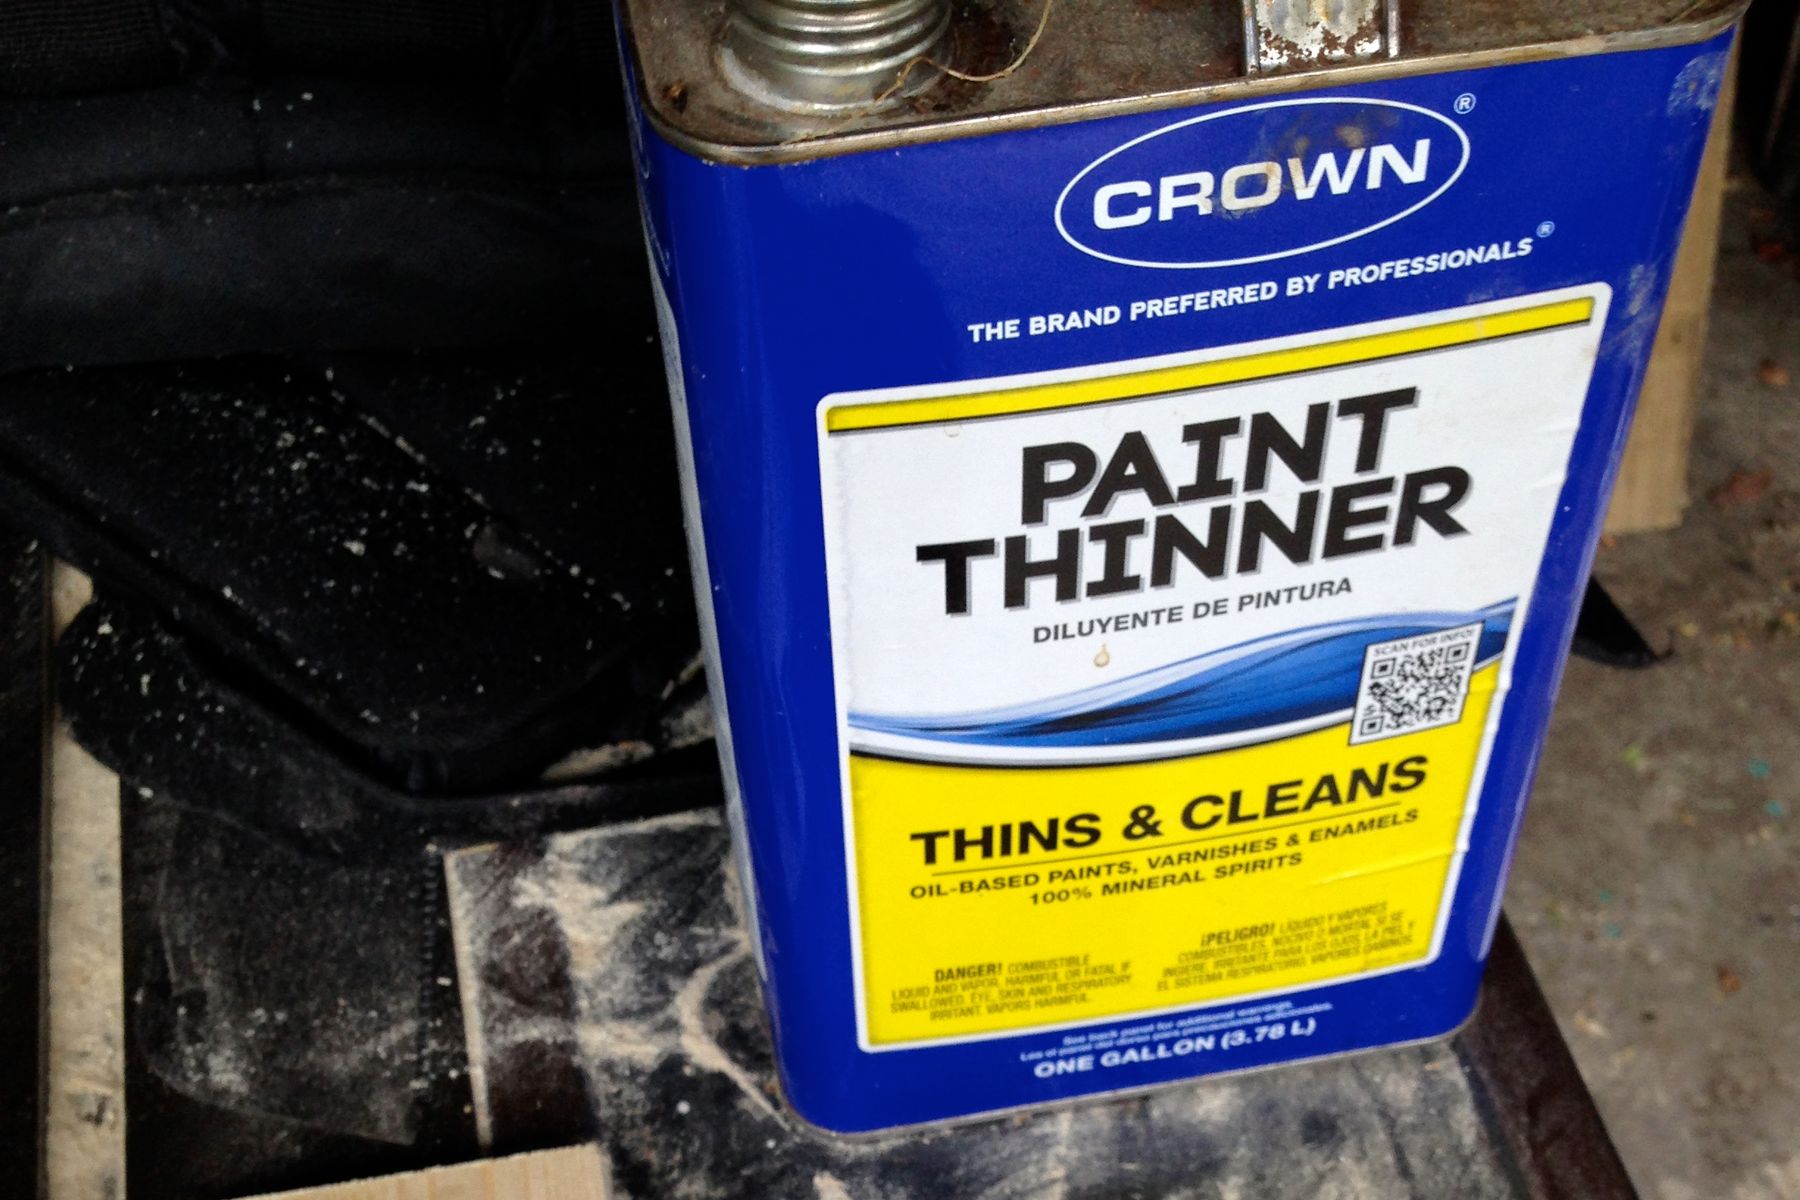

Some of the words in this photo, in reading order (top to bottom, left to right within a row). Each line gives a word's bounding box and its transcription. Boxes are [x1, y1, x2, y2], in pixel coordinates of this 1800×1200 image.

[1093, 138, 1431, 230] CROWN
[967, 319, 1021, 343] THE
[1028, 305, 1122, 336] BRAND
[1129, 281, 1279, 321] PREFERRED
[1286, 273, 1322, 297] BY
[1327, 237, 1534, 290] PROFESSIONALS
[1021, 386, 1418, 525] PAINT
[915, 465, 1474, 616] THINNER
[1033, 603, 1186, 644] DILUYENTE
[1193, 598, 1225, 620] DE
[1238, 577, 1353, 612] PINTURA
[1374, 641, 1409, 656] SCAN
[1412, 636, 1438, 649] FOR
[910, 812, 1101, 866] THINS
[1122, 804, 1163, 841] &
[1181, 755, 1428, 832] CLEANS
[910, 873, 1040, 899] OIL-BASED
[1049, 860, 1138, 883] PAINTS,
[1147, 836, 1278, 870] VARNISHES
[1286, 833, 1300, 847] &
[1309, 808, 1419, 843] ENAMELS
[1030, 886, 1093, 906] 100%
[1101, 869, 1206, 897] MINERAL
[1214, 852, 1304, 880] SPIRITS
[933, 982, 958, 997] AND
[934, 962, 1003, 983] DANGER!
[1033, 1054, 1096, 1079] ONE
[1099, 1034, 1216, 1068] GALLON
[1220, 1022, 1286, 1051] (3.78
[1290, 1016, 1317, 1037] L)
